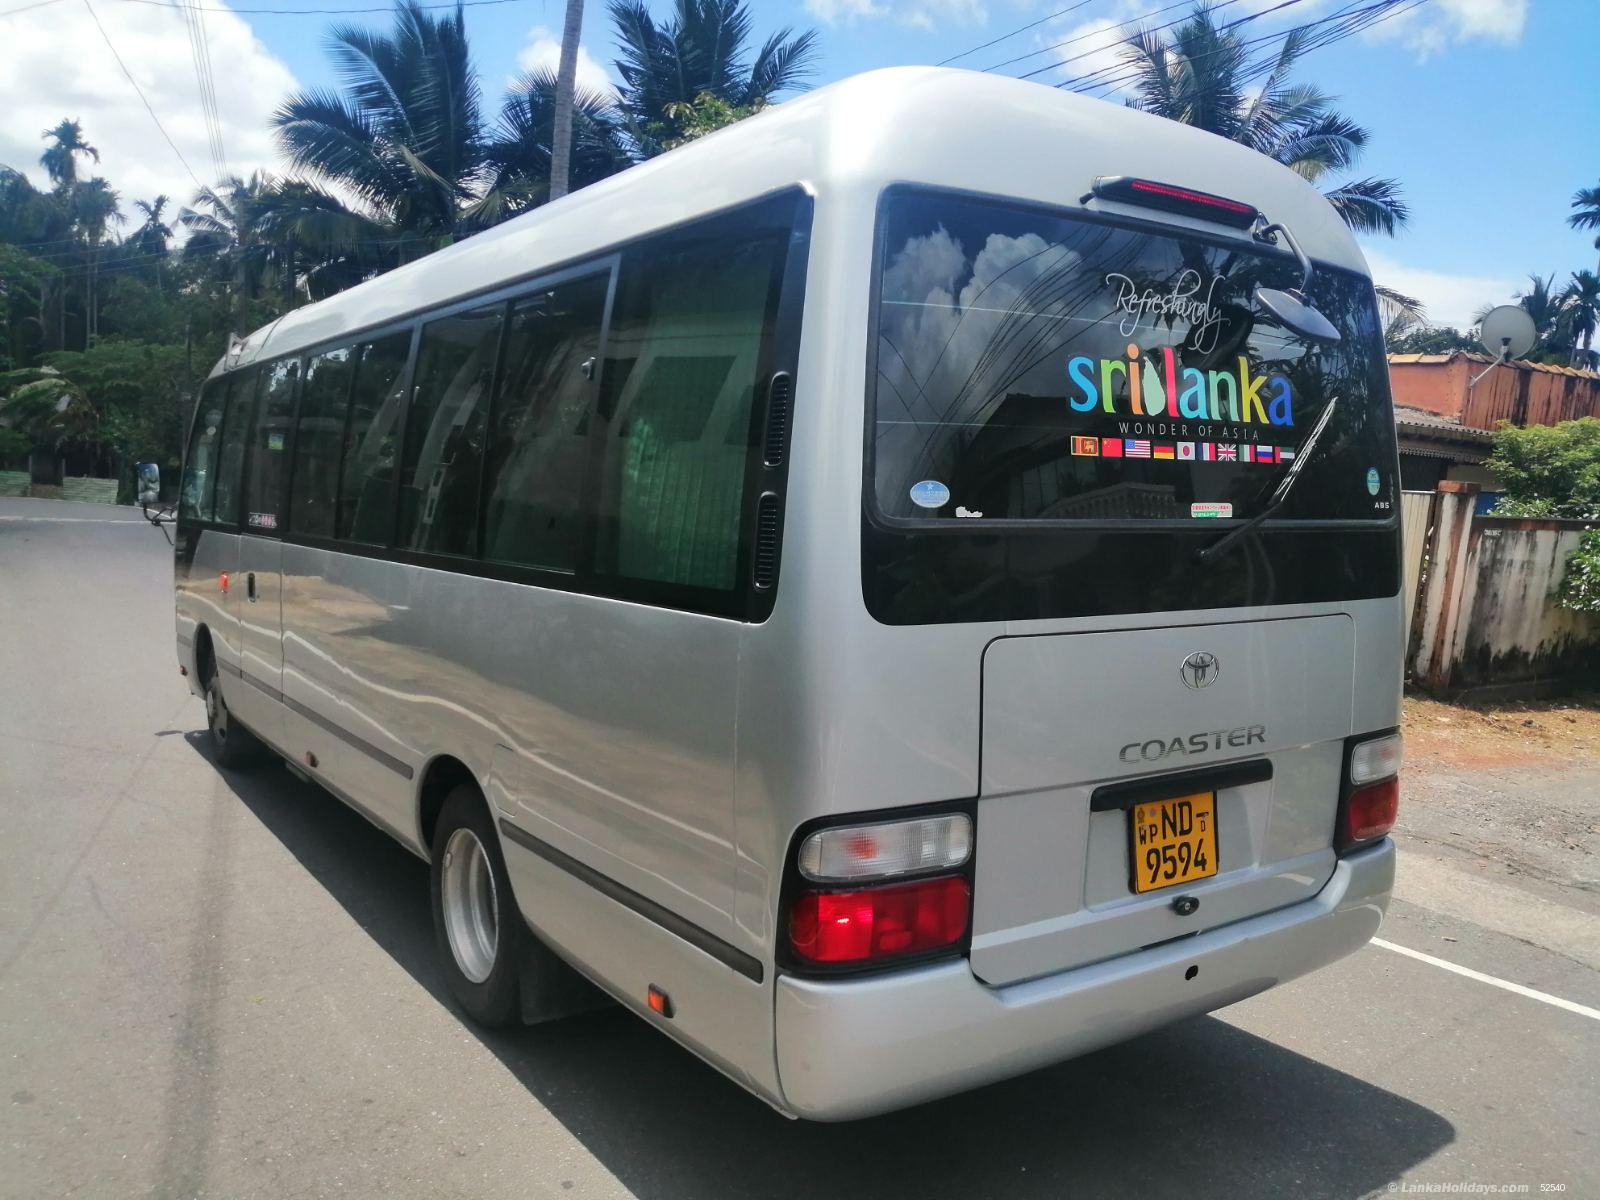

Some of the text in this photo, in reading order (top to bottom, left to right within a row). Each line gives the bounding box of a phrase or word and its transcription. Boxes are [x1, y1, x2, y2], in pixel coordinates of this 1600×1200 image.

[1105, 269, 1231, 354] Refreshingly
[1118, 421, 1260, 441] WONDER OF ASIA
[1374, 501, 1390, 509] ABS
[1119, 724, 1266, 763] COASTER
[1146, 838, 1207, 884] 9594
